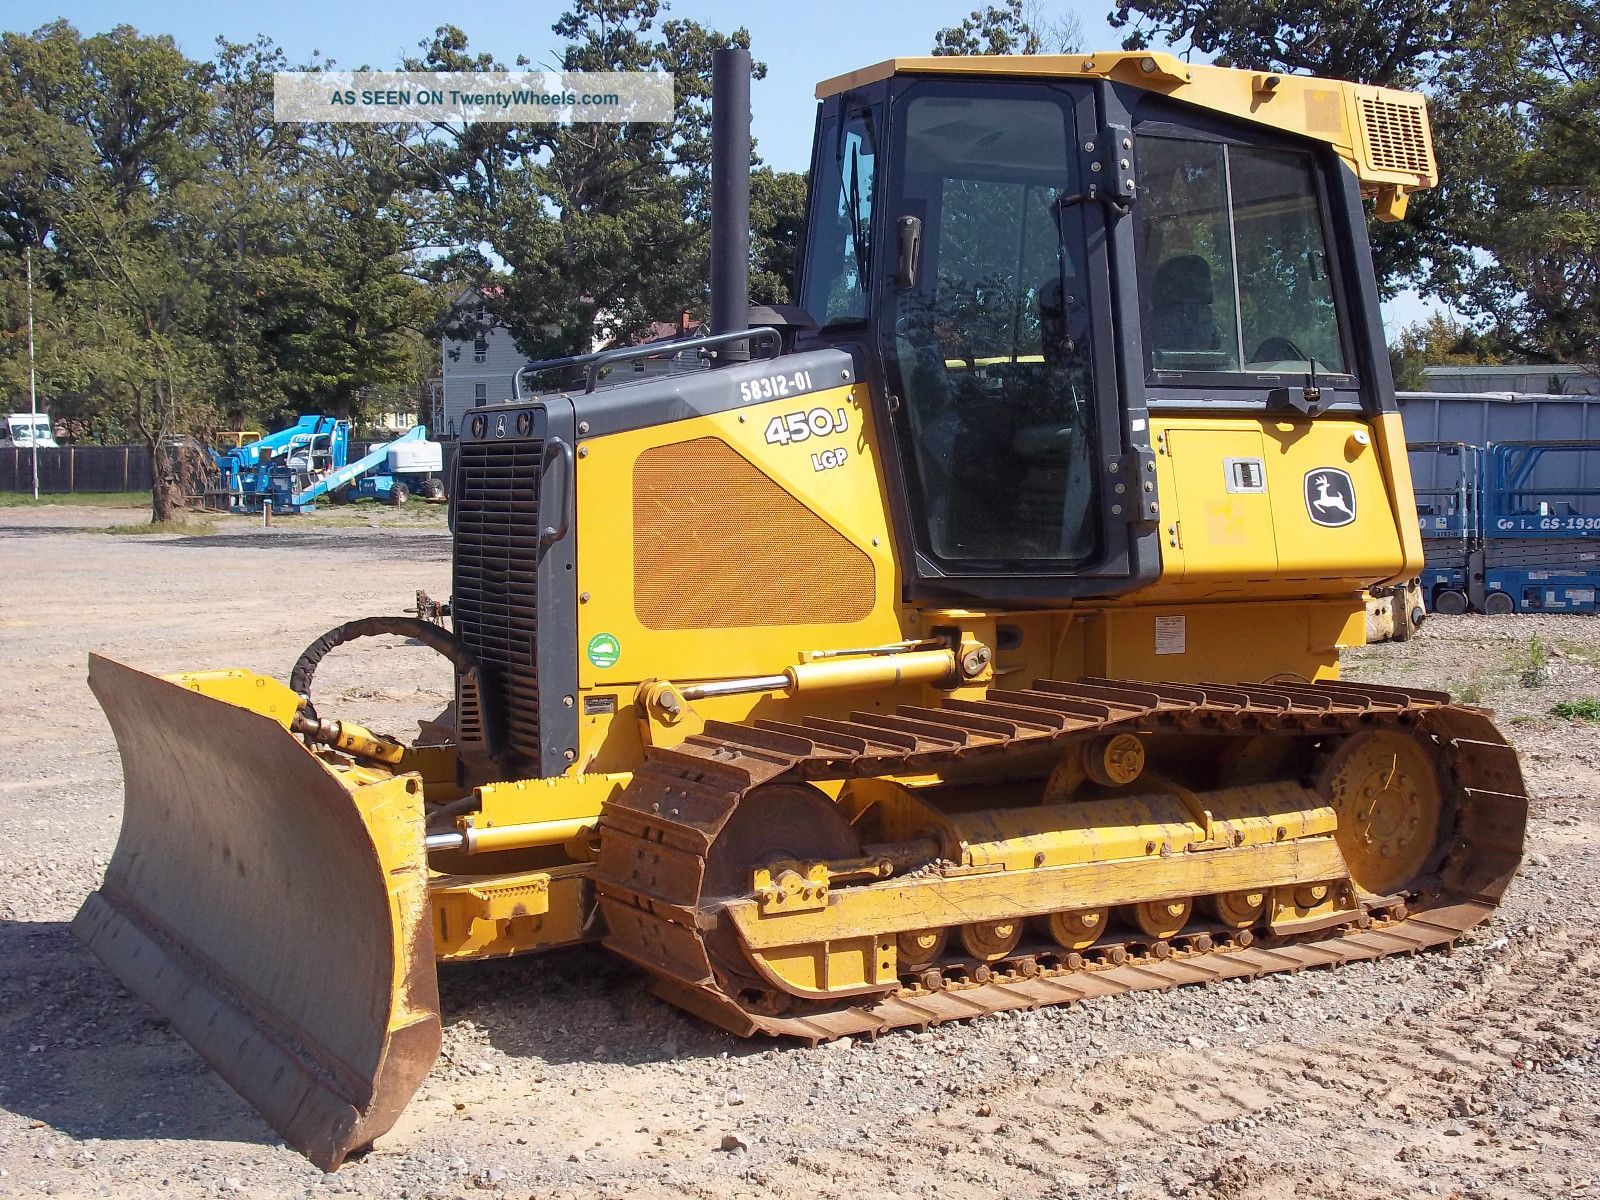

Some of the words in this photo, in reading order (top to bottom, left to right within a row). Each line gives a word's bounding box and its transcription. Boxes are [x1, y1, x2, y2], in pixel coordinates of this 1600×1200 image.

[740, 370, 812, 402] 58312-01
[764, 407, 848, 446] 450J
[811, 447, 848, 473] LGP
[1540, 517, 1600, 530] GS-1930
